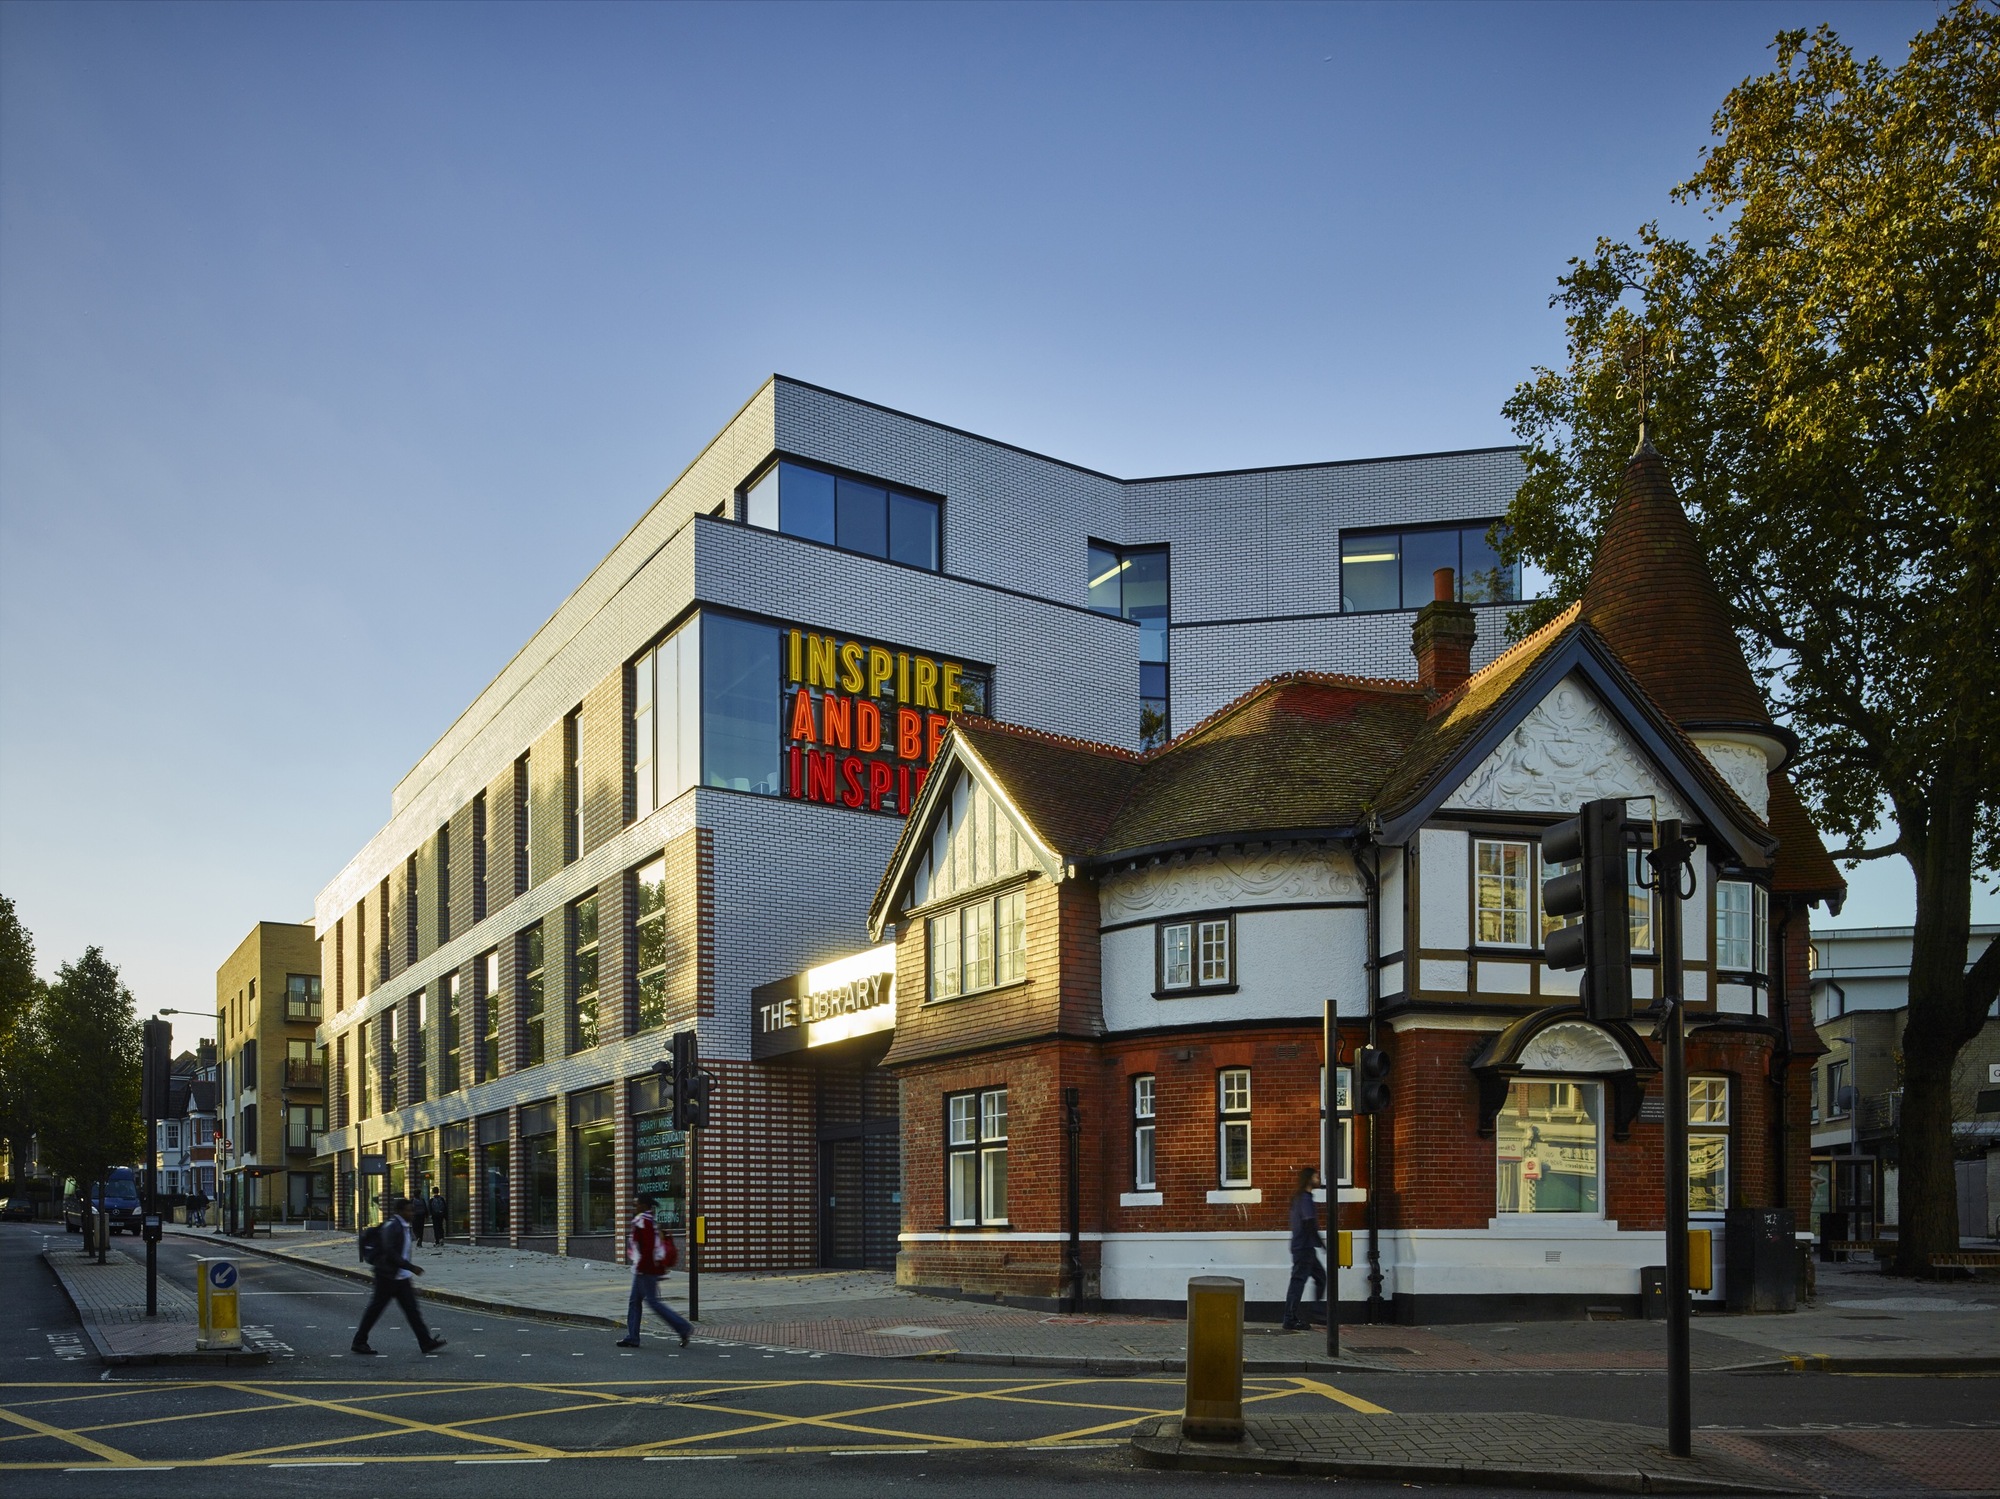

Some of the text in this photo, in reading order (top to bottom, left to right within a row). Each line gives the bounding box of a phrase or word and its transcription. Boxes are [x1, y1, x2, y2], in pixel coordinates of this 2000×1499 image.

[789, 628, 963, 713] INSPIRE
[791, 688, 948, 763] AND BE
[789, 746, 930, 815] INSPI
[760, 972, 894, 1033] THE LIBRARY
[659, 1116, 674, 1128] MUSE
